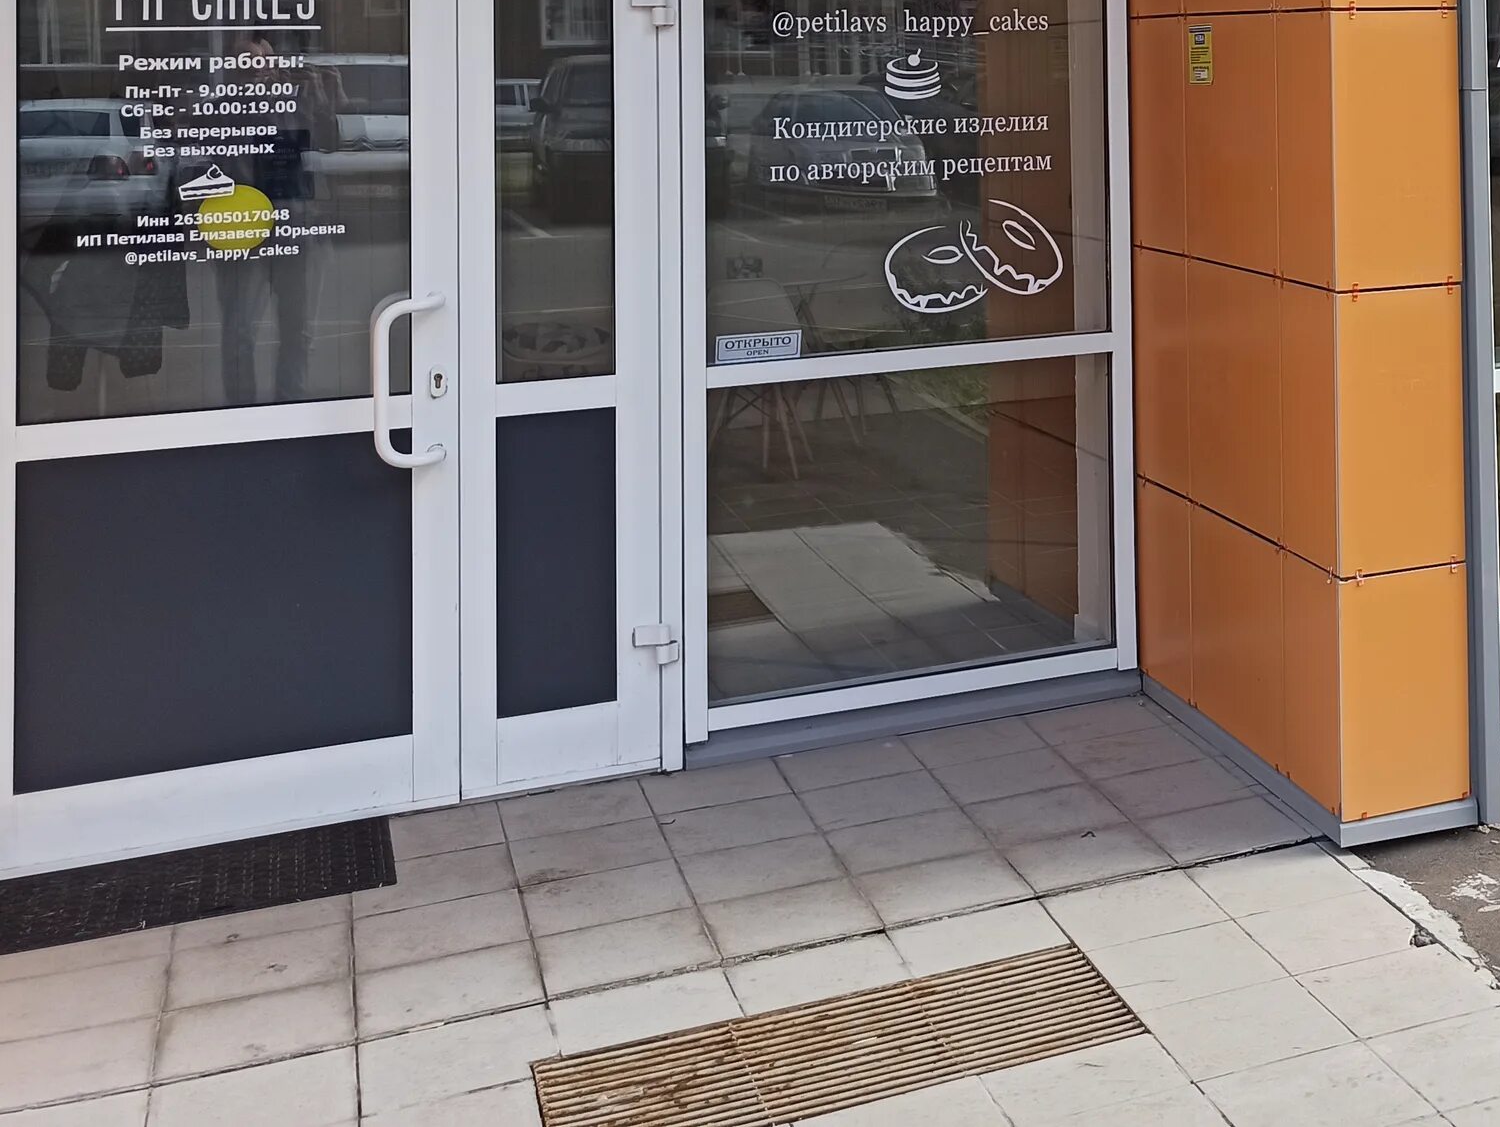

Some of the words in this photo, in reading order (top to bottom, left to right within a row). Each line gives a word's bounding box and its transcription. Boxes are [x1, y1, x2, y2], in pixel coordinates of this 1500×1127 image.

[118, 54, 202, 71] Режим
[209, 53, 304, 73] работы:
[125, 85, 181, 99] Пн-Пт
[199, 83, 293, 98] 9.00:20.00
[120, 103, 174, 118] Сб-Вс
[192, 101, 297, 115] 10.00:19.00
[139, 126, 172, 140] Без
[177, 125, 278, 140] перерывов
[772, 117, 947, 141] Кондитерские
[953, 115, 1049, 136] изделия
[143, 144, 175, 158] Без
[180, 143, 275, 157] выходных
[770, 165, 800, 182] по
[807, 159, 935, 184] авторским
[942, 154, 1052, 179] рецептам
[137, 215, 169, 227] Инн
[173, 209, 290, 226] 263605017048
[76, 234, 102, 248] ИП
[106, 230, 185, 246] Петилава
[189, 226, 270, 242] Елизавета
[275, 222, 346, 239] Юрьевна
[124, 243, 300, 266] @petilavs_happy_cakes
[724, 336, 792, 350] ОТКРЫТО
